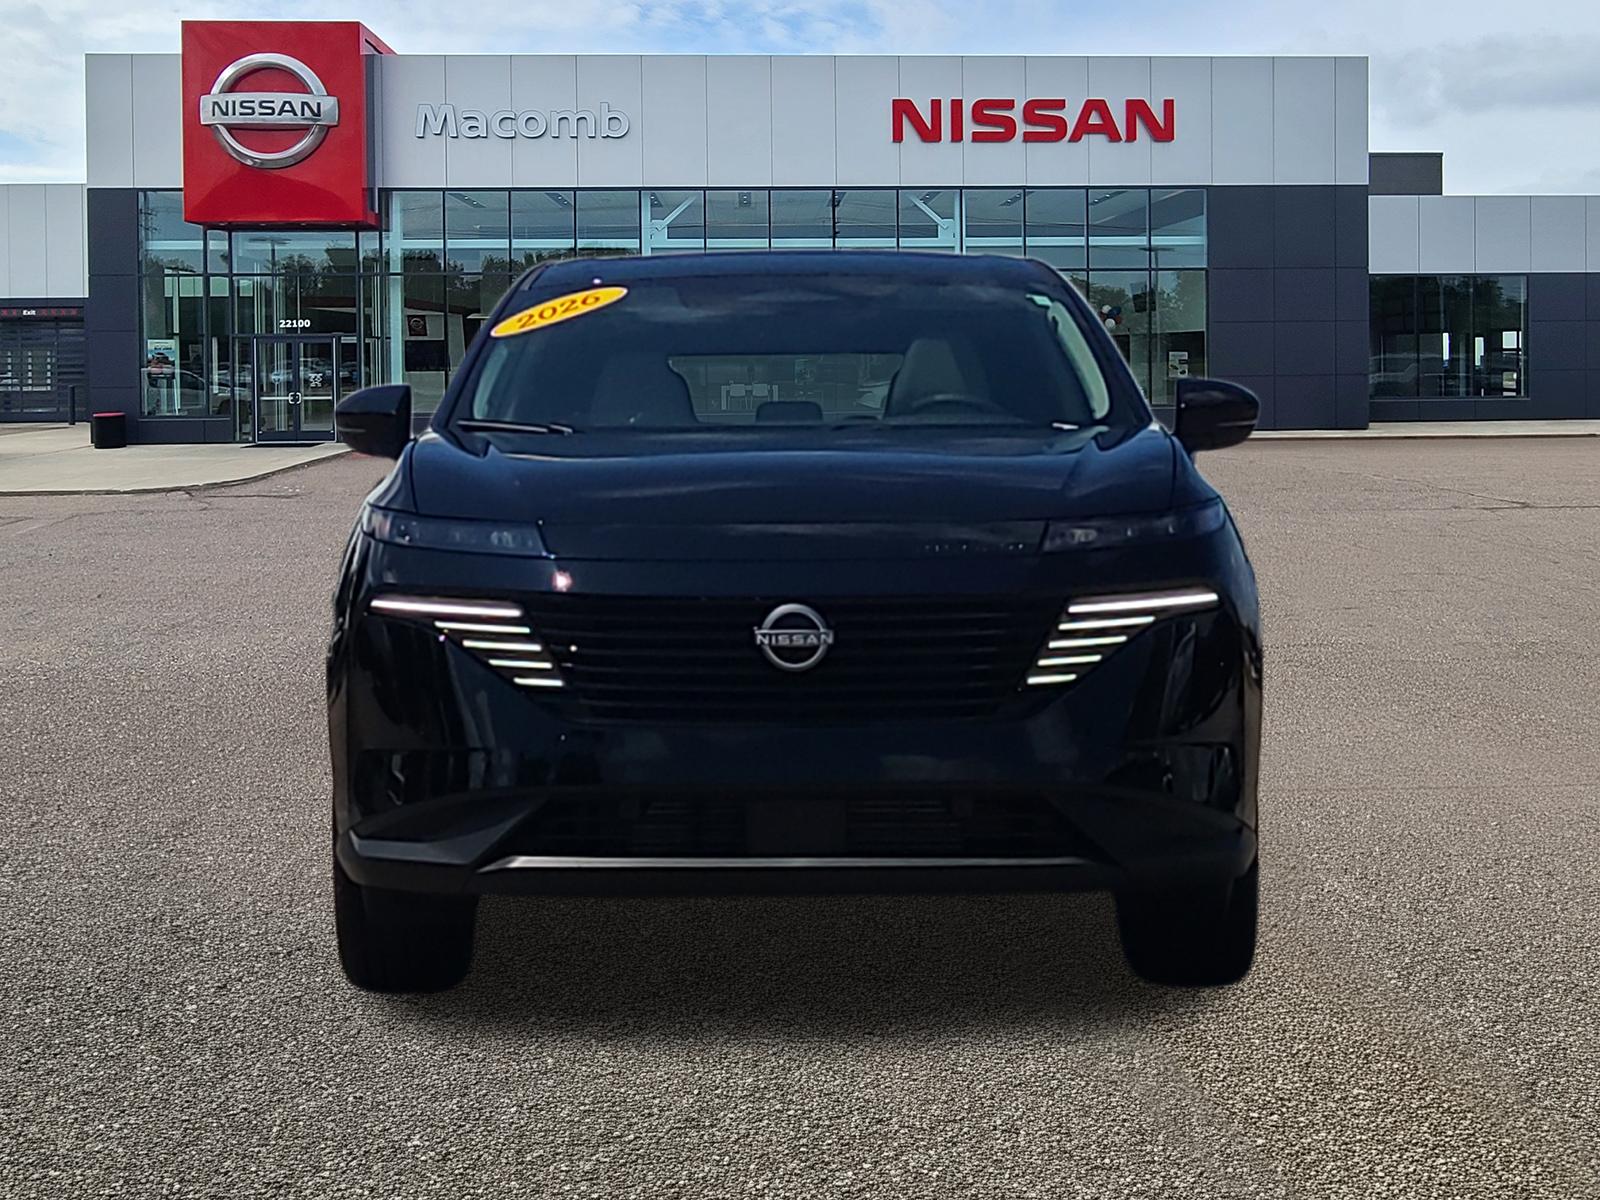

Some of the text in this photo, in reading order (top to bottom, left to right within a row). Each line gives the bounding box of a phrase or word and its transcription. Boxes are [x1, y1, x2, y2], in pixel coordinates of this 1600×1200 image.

[212, 100, 322, 117] NISSAN
[415, 102, 630, 138] Macomb
[891, 98, 1175, 142] NISSAN
[279, 319, 311, 328] 22100
[517, 294, 600, 329] 2026
[756, 632, 834, 646] NISSAN
